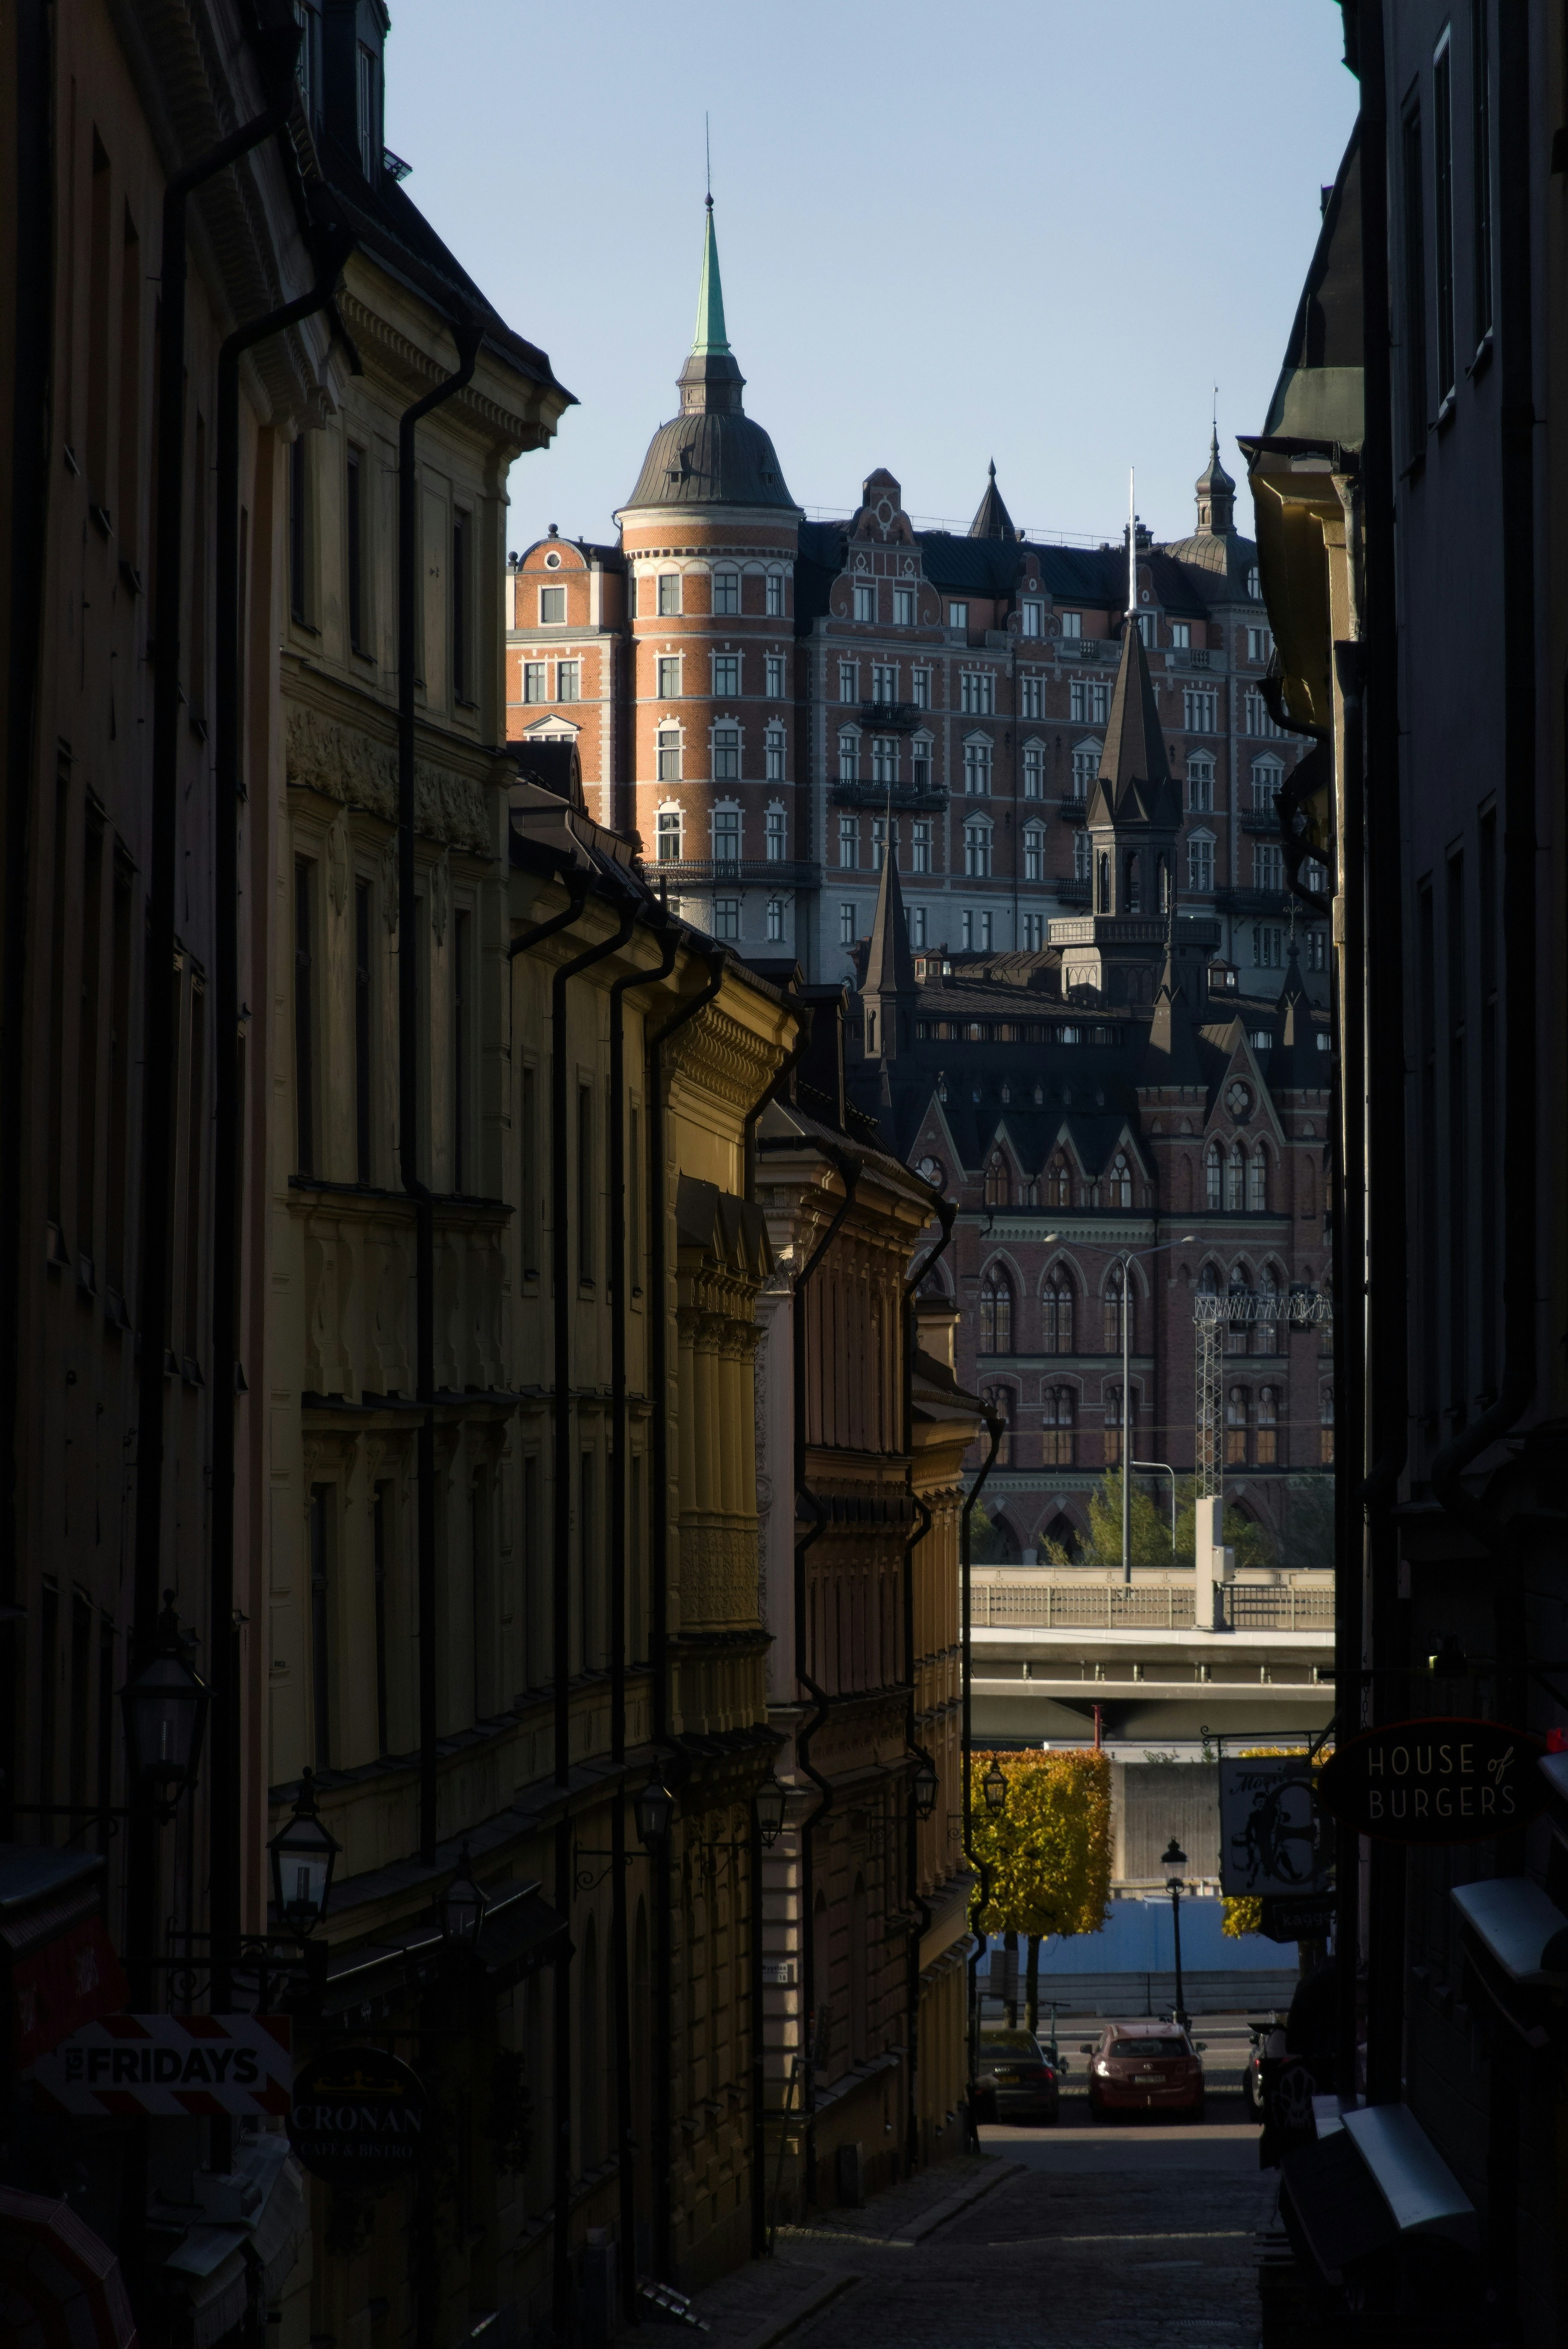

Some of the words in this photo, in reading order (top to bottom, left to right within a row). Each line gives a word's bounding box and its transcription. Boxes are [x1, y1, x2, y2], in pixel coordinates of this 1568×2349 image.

[1368, 1744, 1475, 1776] HOUSE
[1487, 1745, 1515, 1785] of
[1369, 1785, 1516, 1819] BURGERS
[65, 2048, 83, 2082] TGI
[87, 2047, 258, 2083] FRIDAYS
[291, 2103, 423, 2134] CRONAN
[301, 2138, 339, 2157] CAFÉ
[343, 2143, 354, 2156] &
[359, 2143, 413, 2158] BISTRO
